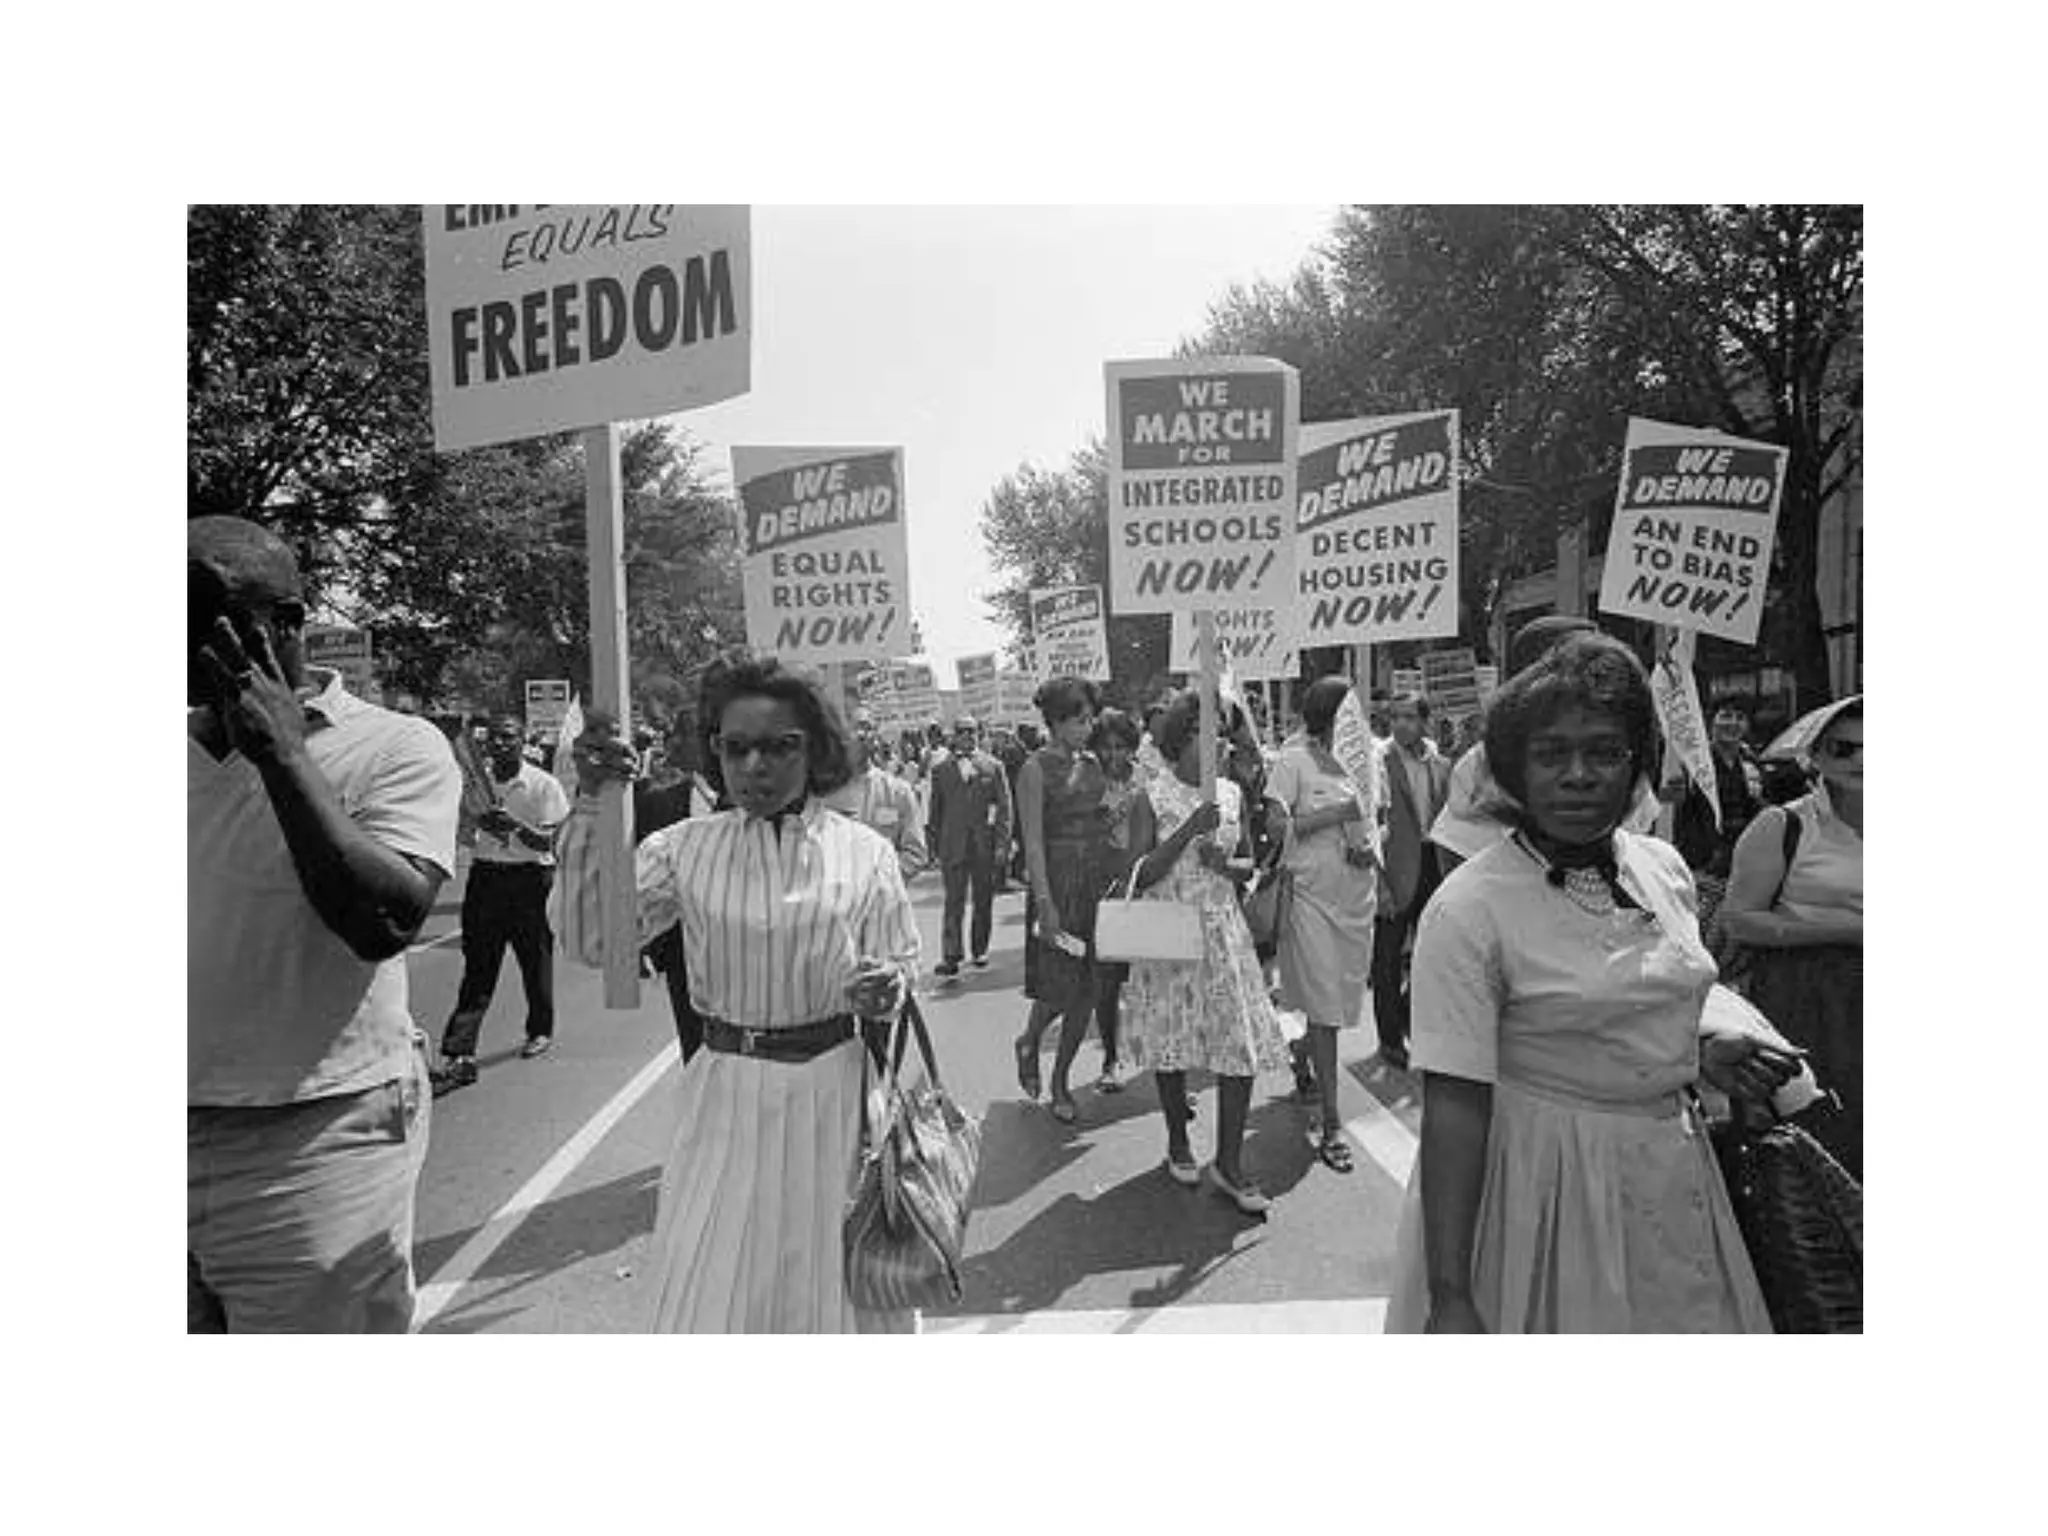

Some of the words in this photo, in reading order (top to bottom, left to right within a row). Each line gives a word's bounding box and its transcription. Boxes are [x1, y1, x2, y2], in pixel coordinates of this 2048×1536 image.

[502, 204, 674, 270] EQUALS
[452, 249, 737, 388] FREEDOM
[1179, 380, 1230, 407] WE
[1133, 408, 1273, 444] MARCH
[1178, 444, 1231, 464] FOR
[1336, 431, 1399, 477] WE
[1675, 448, 1735, 475] WE
[793, 463, 848, 500] WE
[1122, 475, 1285, 507] INTEGRATED
[1297, 451, 1445, 525] DEMAND
[1633, 475, 1771, 505] DEMAND
[756, 485, 892, 544] DEMAND
[1124, 516, 1282, 547] SCHOOLS
[1312, 522, 1437, 557] DECENT
[1633, 515, 1682, 544] AN
[1692, 525, 1760, 560] END
[772, 551, 886, 578] EQUAL
[1136, 549, 1276, 596] NOW!
[1300, 557, 1449, 594] HOUSING
[1633, 543, 1674, 571] TO
[1682, 552, 1754, 588] BIAS
[772, 579, 892, 608] RIGHTS
[1309, 584, 1442, 630] NOW!
[1627, 575, 1750, 622] NOW!
[776, 606, 896, 650] NOW!
[1188, 632, 1277, 660] OW!
